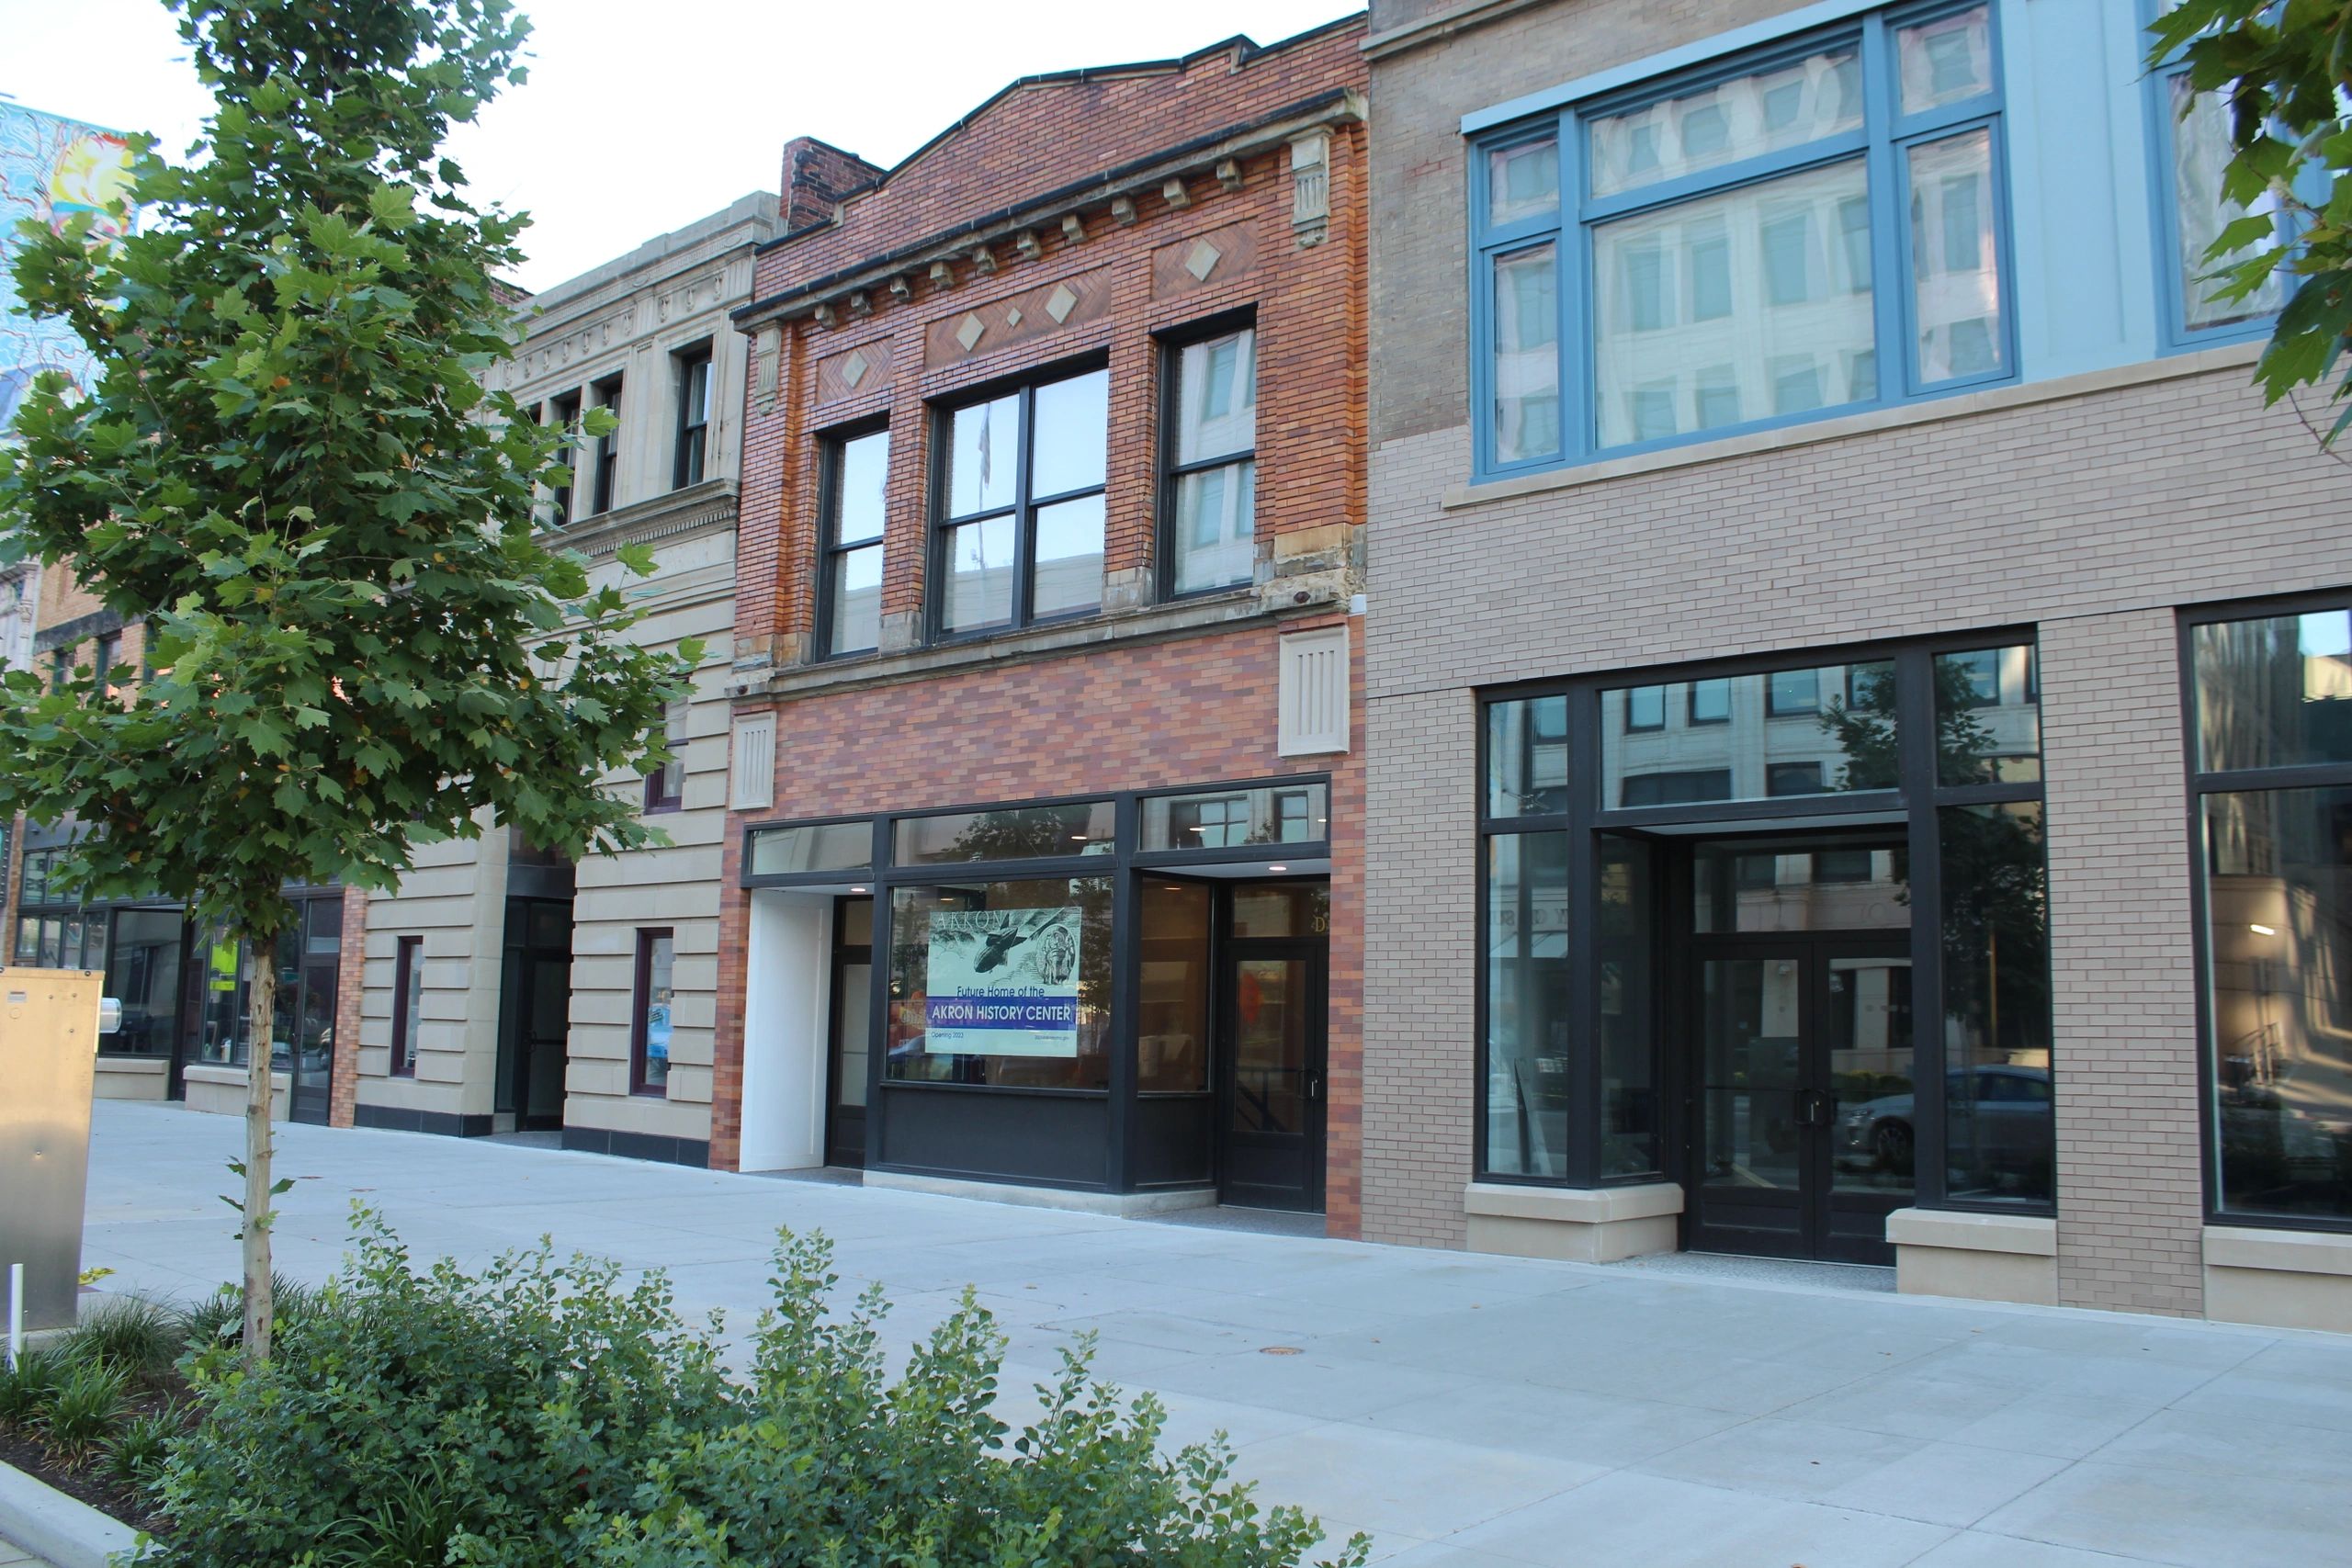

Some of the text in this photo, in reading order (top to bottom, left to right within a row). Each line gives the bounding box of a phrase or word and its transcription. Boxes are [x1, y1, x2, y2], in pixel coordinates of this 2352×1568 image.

[956, 986, 1045, 998] Future Home of the
[932, 1005, 973, 1021] AKRON
[976, 1005, 1024, 1021] HISTORY
[1025, 1005, 1070, 1021] CENTER
[932, 1032, 952, 1040] Opening
